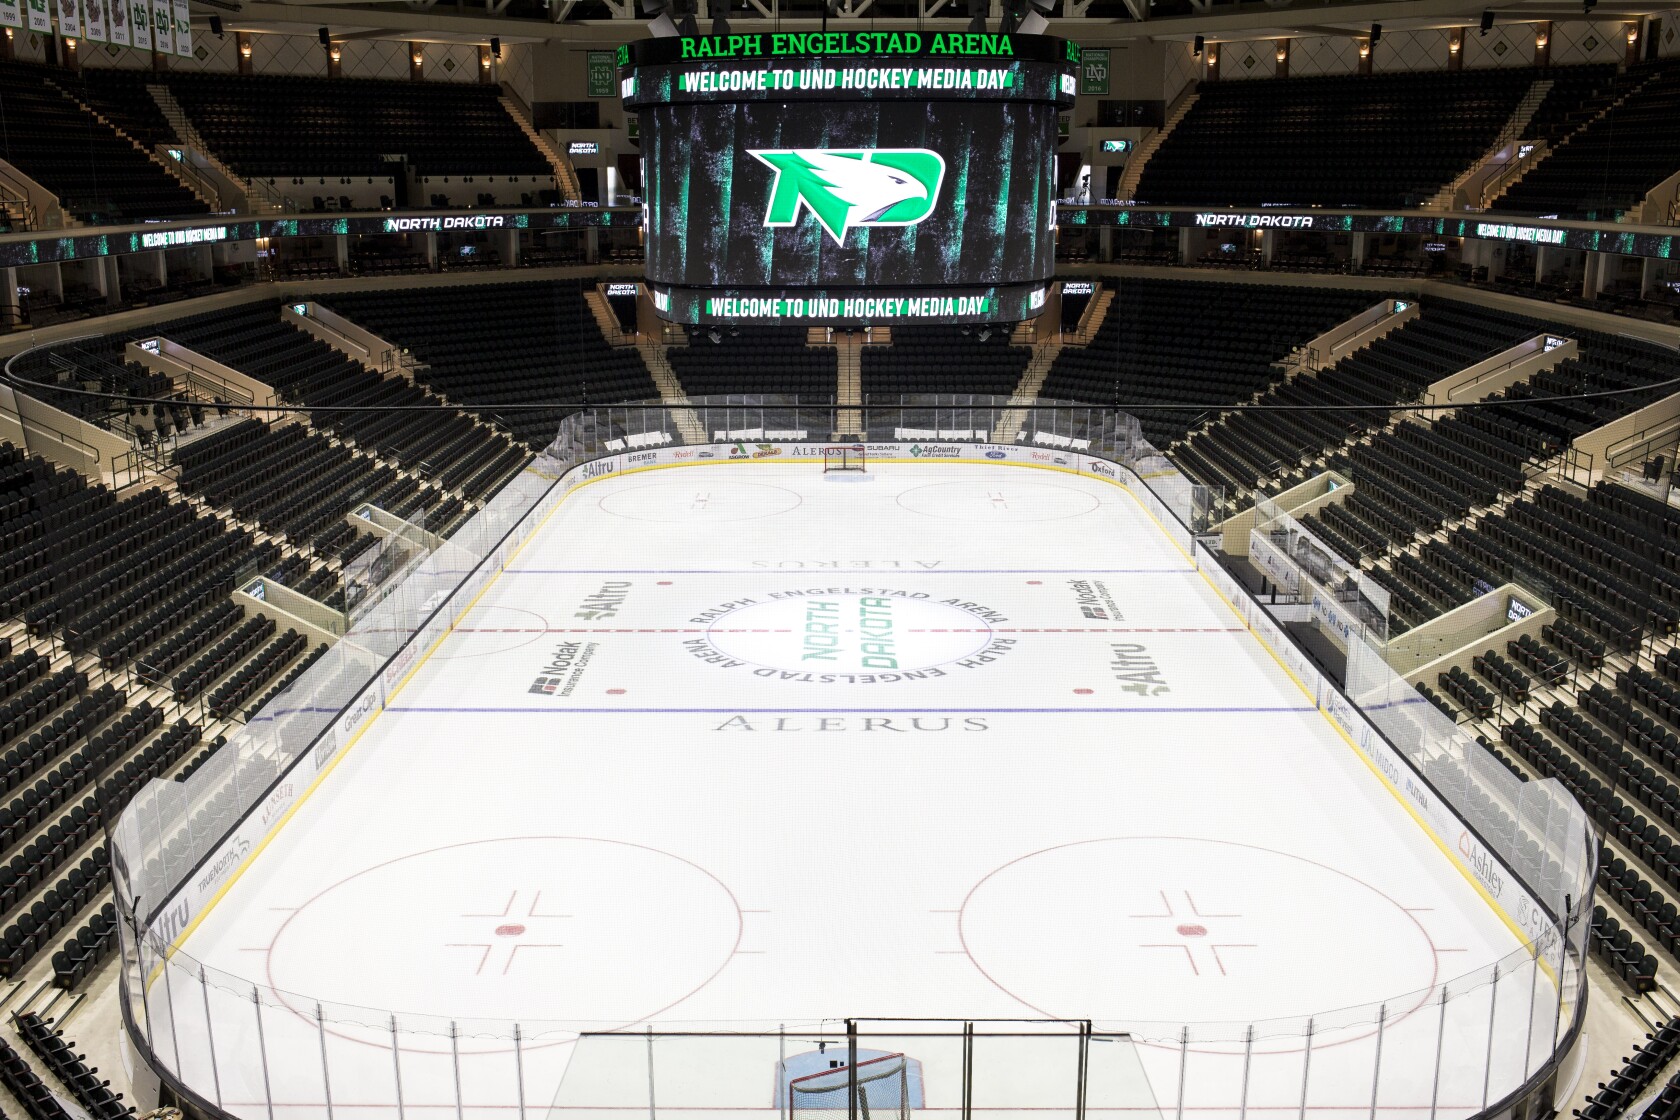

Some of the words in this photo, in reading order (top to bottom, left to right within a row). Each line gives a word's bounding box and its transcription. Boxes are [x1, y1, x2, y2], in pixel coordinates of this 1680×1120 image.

[3, 12, 16, 22] 1999
[34, 17, 46, 27] 2001
[681, 35, 762, 58] RALPH
[772, 33, 922, 55] ENGELSTAD
[930, 33, 1014, 55] ARENA
[685, 70, 768, 92] WELCOME
[773, 69, 794, 90] TO
[800, 69, 836, 90] UND
[841, 68, 914, 89] HOCKEY
[917, 68, 972, 89] MEDIA
[977, 69, 1008, 90] DAY
[387, 217, 441, 232] NORTH
[443, 216, 504, 229] DAKOTA
[1195, 213, 1247, 227] NORTH
[1249, 215, 1313, 228] DAKOTA
[1477, 223, 1500, 238] WELCOME
[143, 232, 168, 248] WELCOME
[710, 298, 781, 318] WELCOME
[785, 298, 803, 318] TO
[808, 298, 839, 318] UND
[843, 297, 905, 318] HOCKEY
[907, 296, 954, 317] MEDIA
[957, 295, 985, 316] DAY
[628, 452, 657, 463] BREMER
[791, 445, 842, 456] ALERUS
[922, 445, 962, 455] AgCountry
[588, 461, 614, 479] Altru
[1091, 462, 1115, 477] Oxford
[752, 560, 944, 569] ALERUS
[579, 581, 633, 612] Altru
[1065, 579, 1101, 606] Nodak
[689, 597, 758, 624] RALPH
[767, 587, 931, 600] ENGELSTAD
[940, 597, 1010, 624] ARENA
[801, 600, 845, 661] NORTH
[860, 596, 899, 670] DAKOTA
[540, 641, 582, 676] Nodak
[682, 637, 745, 669] ARENA
[956, 637, 1017, 670] RALPH
[1110, 643, 1168, 685] Altru
[752, 667, 947, 684] ENGELSTAD
[712, 714, 990, 732] ALERUS
[1469, 843, 1504, 899] Ashley
